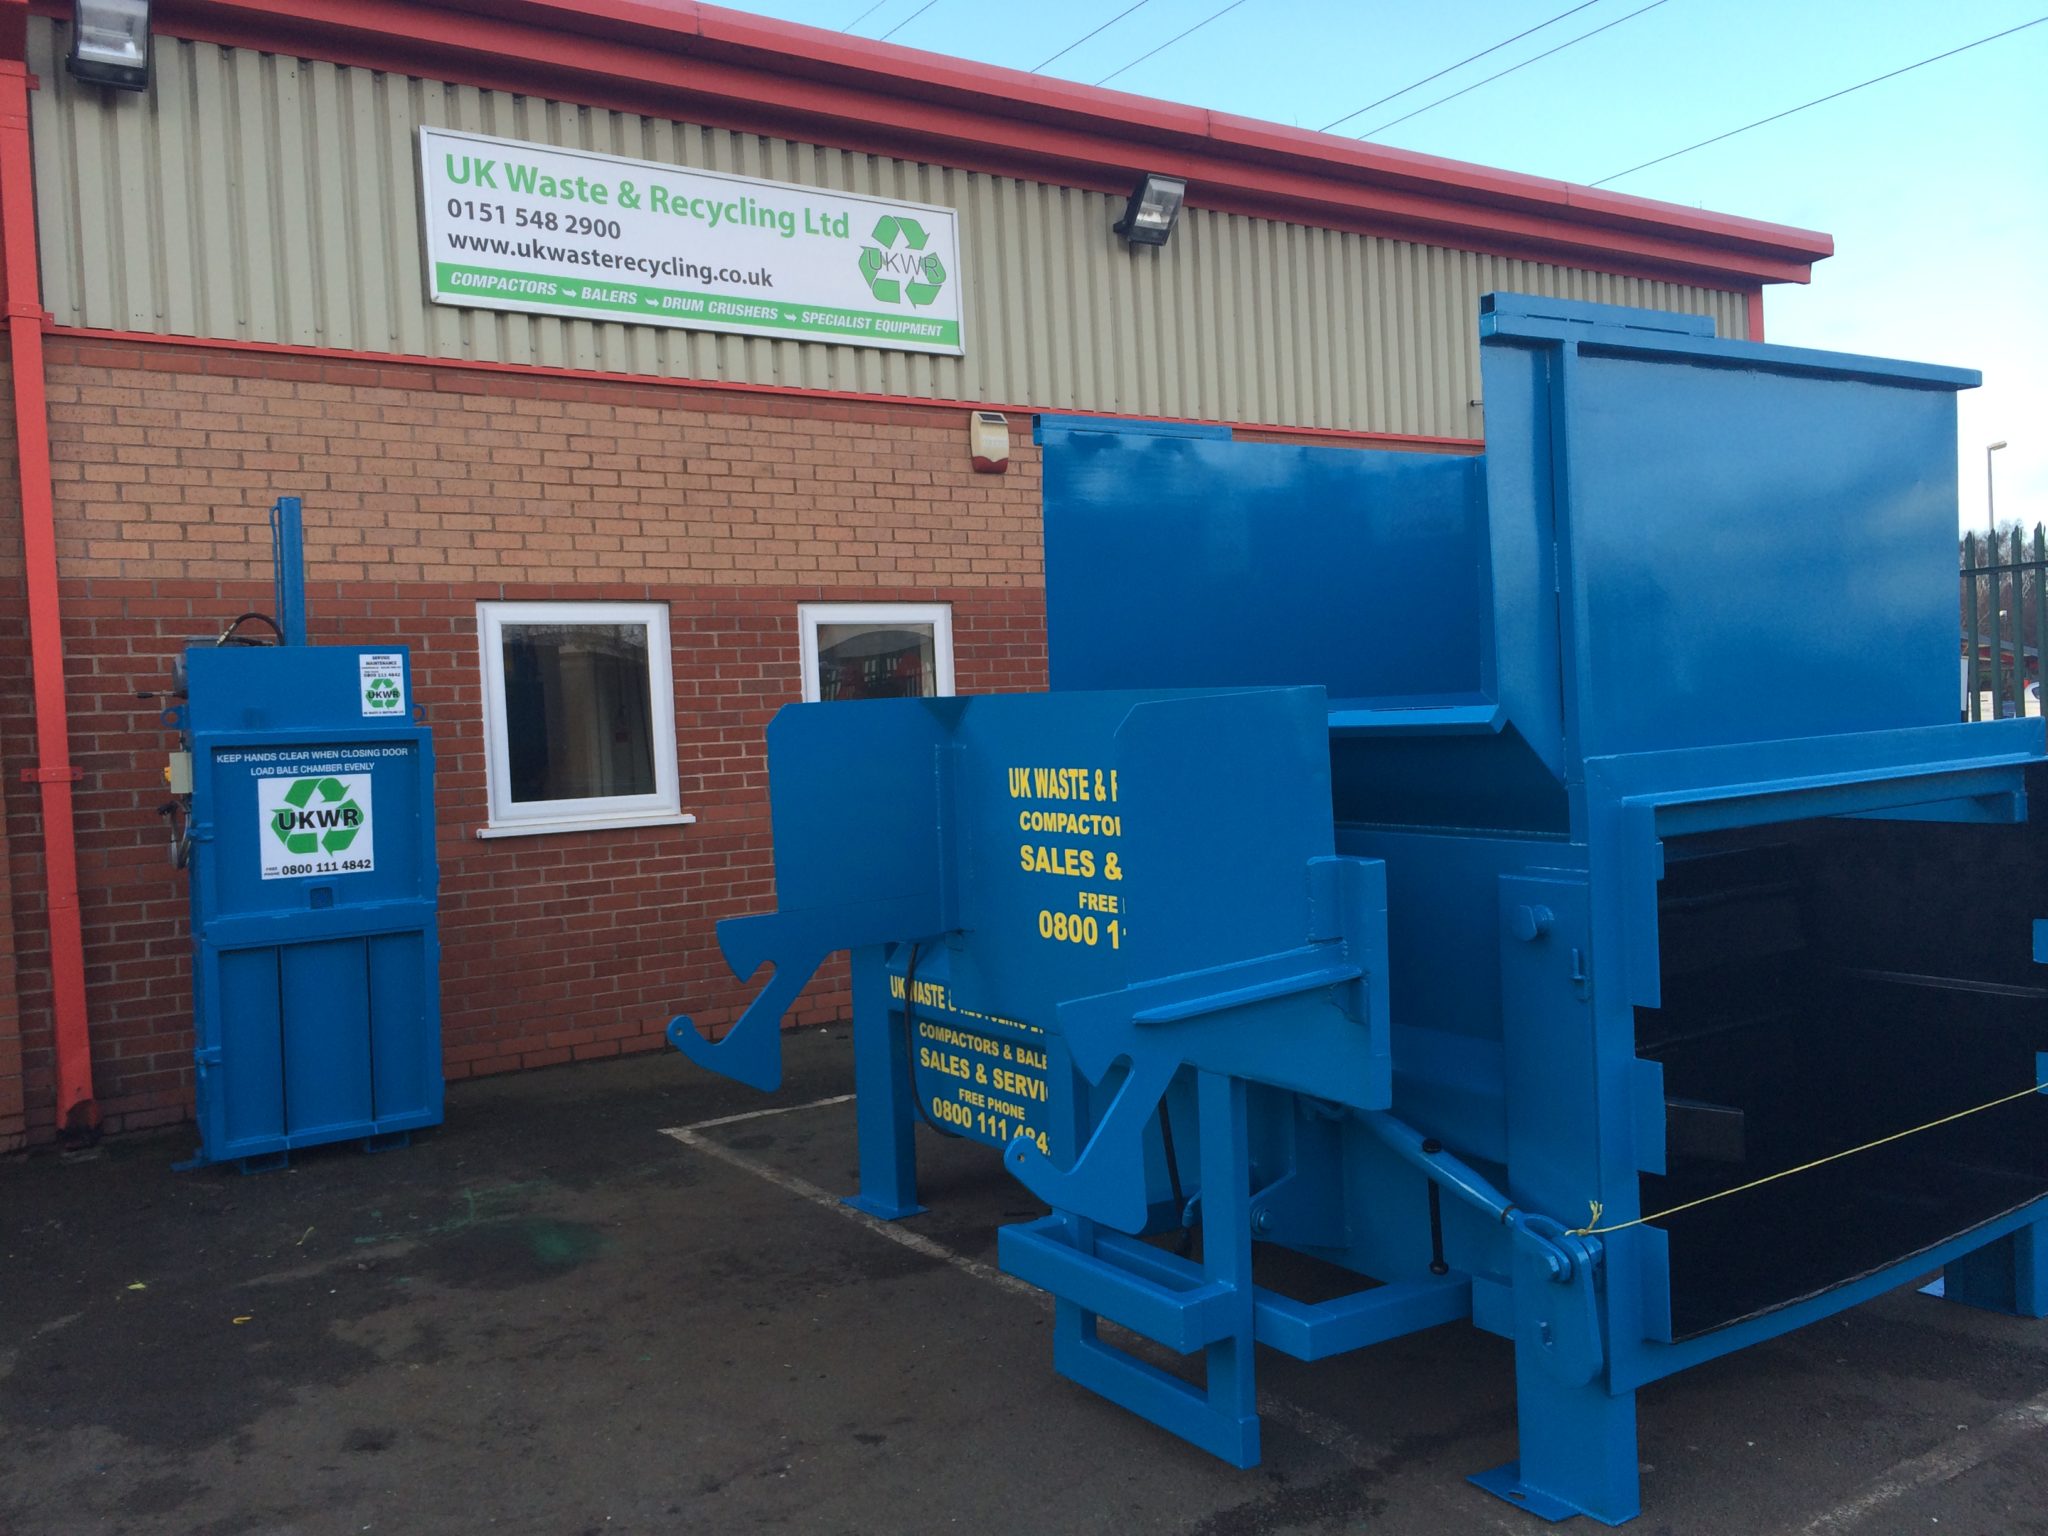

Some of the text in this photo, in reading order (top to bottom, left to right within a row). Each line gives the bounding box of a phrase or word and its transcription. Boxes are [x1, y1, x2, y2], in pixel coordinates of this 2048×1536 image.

[446, 154, 849, 238] UK Waste & Recycling Ltd
[447, 198, 621, 239] 0151 548 2900
[448, 233, 773, 287] www.ukwasterecycling.co.uk
[868, 250, 940, 278] UKWR
[451, 271, 943, 337] COMPACTORS BALERS DRUM CRUSHERS SPECIALIST EQUIPMENT
[216, 748, 408, 763] KEEP HANDS CLEAR WHEN CLOSING DOOR
[250, 762, 375, 776] LOAD BALE CHAMBER EVENLY
[1008, 767, 1032, 798] UK
[1034, 768, 1090, 801] WASTE
[1094, 769, 1107, 802] &
[278, 808, 359, 831] UKWR
[282, 859, 371, 875] 0800 111 4842
[1020, 844, 1123, 881] SALES &
[1078, 891, 1118, 914] FREE
[1039, 910, 1098, 946] 0800
[890, 975, 905, 999] UK
[919, 1022, 999, 1057] COMPACTORS
[1003, 1044, 1012, 1060] &
[920, 1047, 1048, 1102] SALES & SERVI
[932, 1097, 972, 1129] 0800
[977, 1112, 1007, 1141] 111
[959, 1088, 1026, 1120] FREE PHONE
